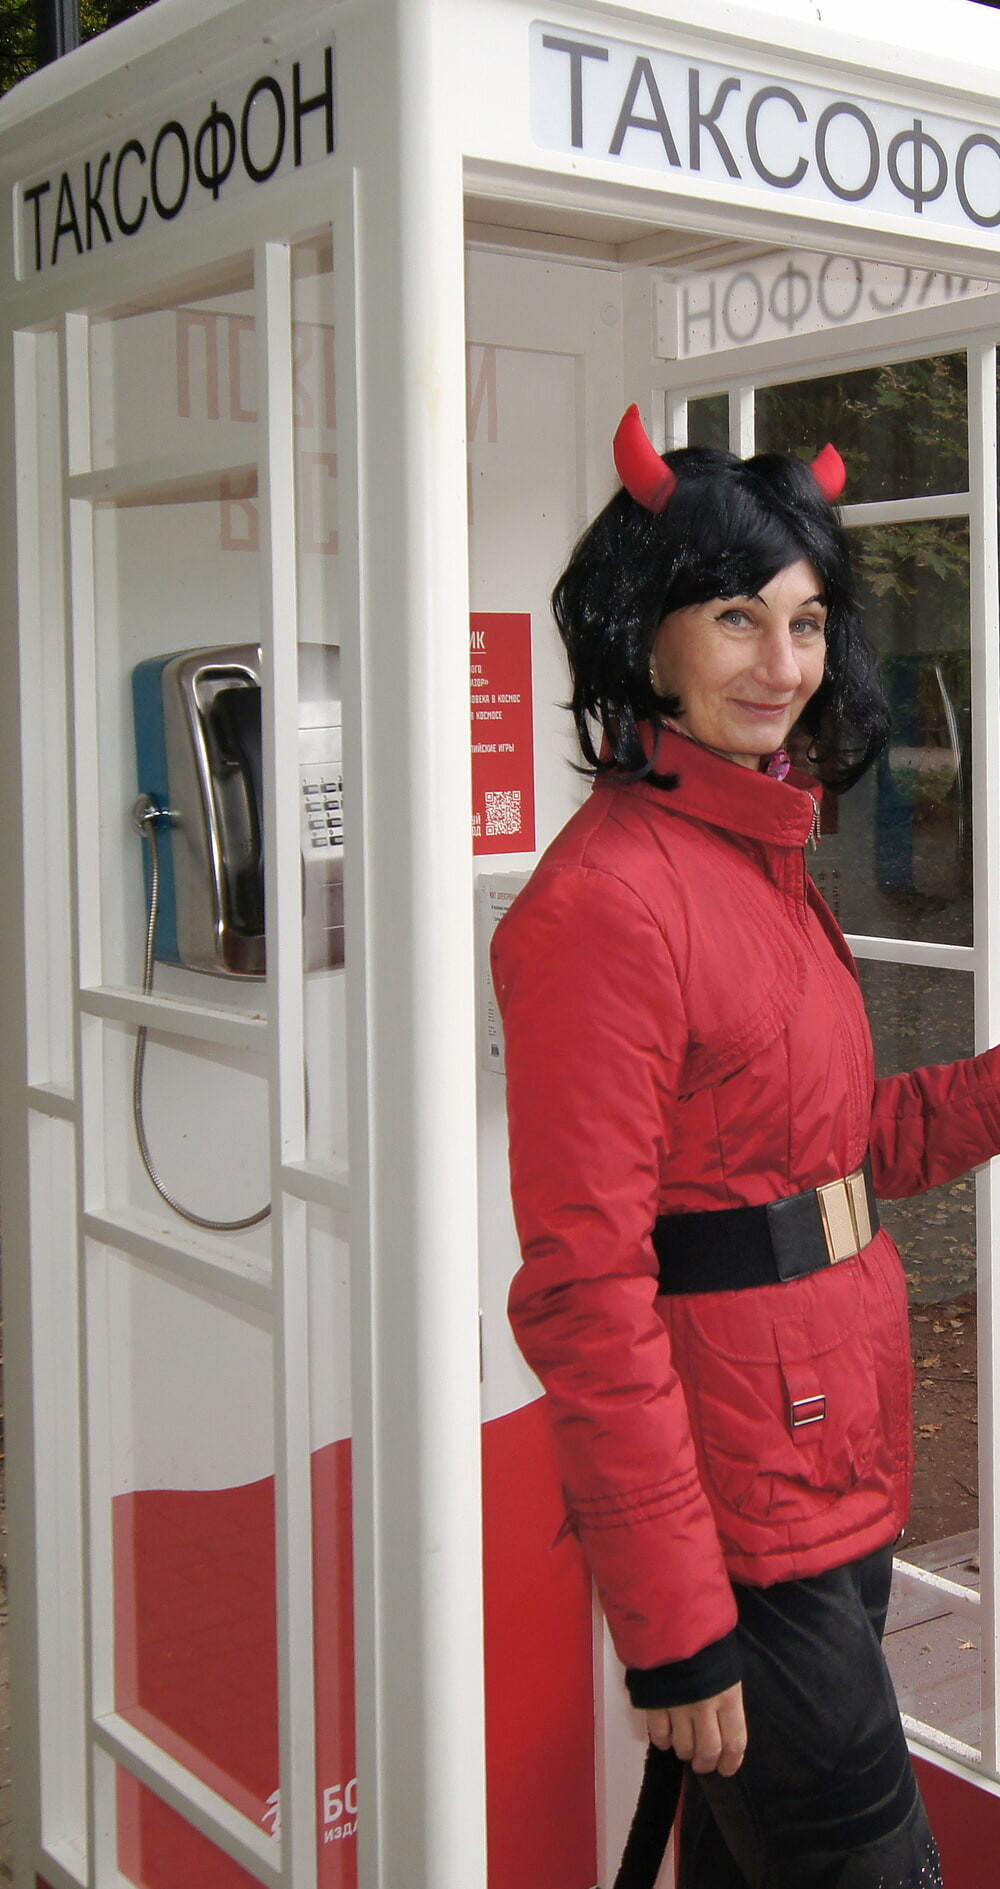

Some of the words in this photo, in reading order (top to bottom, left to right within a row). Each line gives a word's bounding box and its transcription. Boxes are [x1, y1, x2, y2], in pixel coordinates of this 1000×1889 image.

[23, 45, 335, 271] ТАКСОФОН
[471, 694, 490, 704] ОВЕКА
[498, 694, 521, 703] КОСМОС
[476, 711, 503, 720] КОСМОСЕ
[498, 743, 515, 752] ИГРЫ
[323, 1777, 358, 1824] БО
